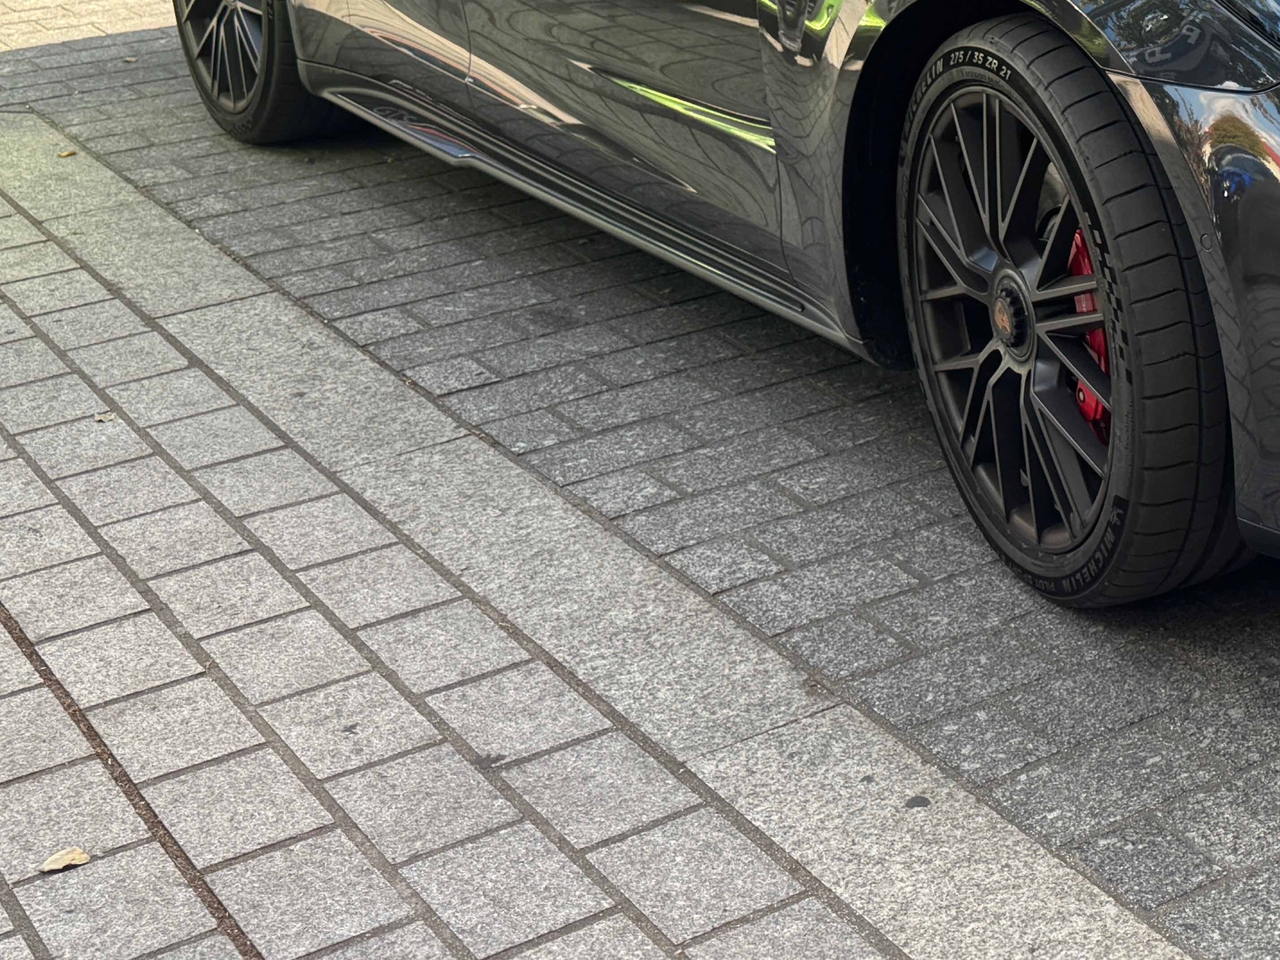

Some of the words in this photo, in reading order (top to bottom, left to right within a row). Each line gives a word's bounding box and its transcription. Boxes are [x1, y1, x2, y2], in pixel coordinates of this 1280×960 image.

[950, 50, 965, 67] 275
[972, 51, 985, 66] 35
[985, 56, 999, 72] ZR
[999, 65, 1012, 81] 21
